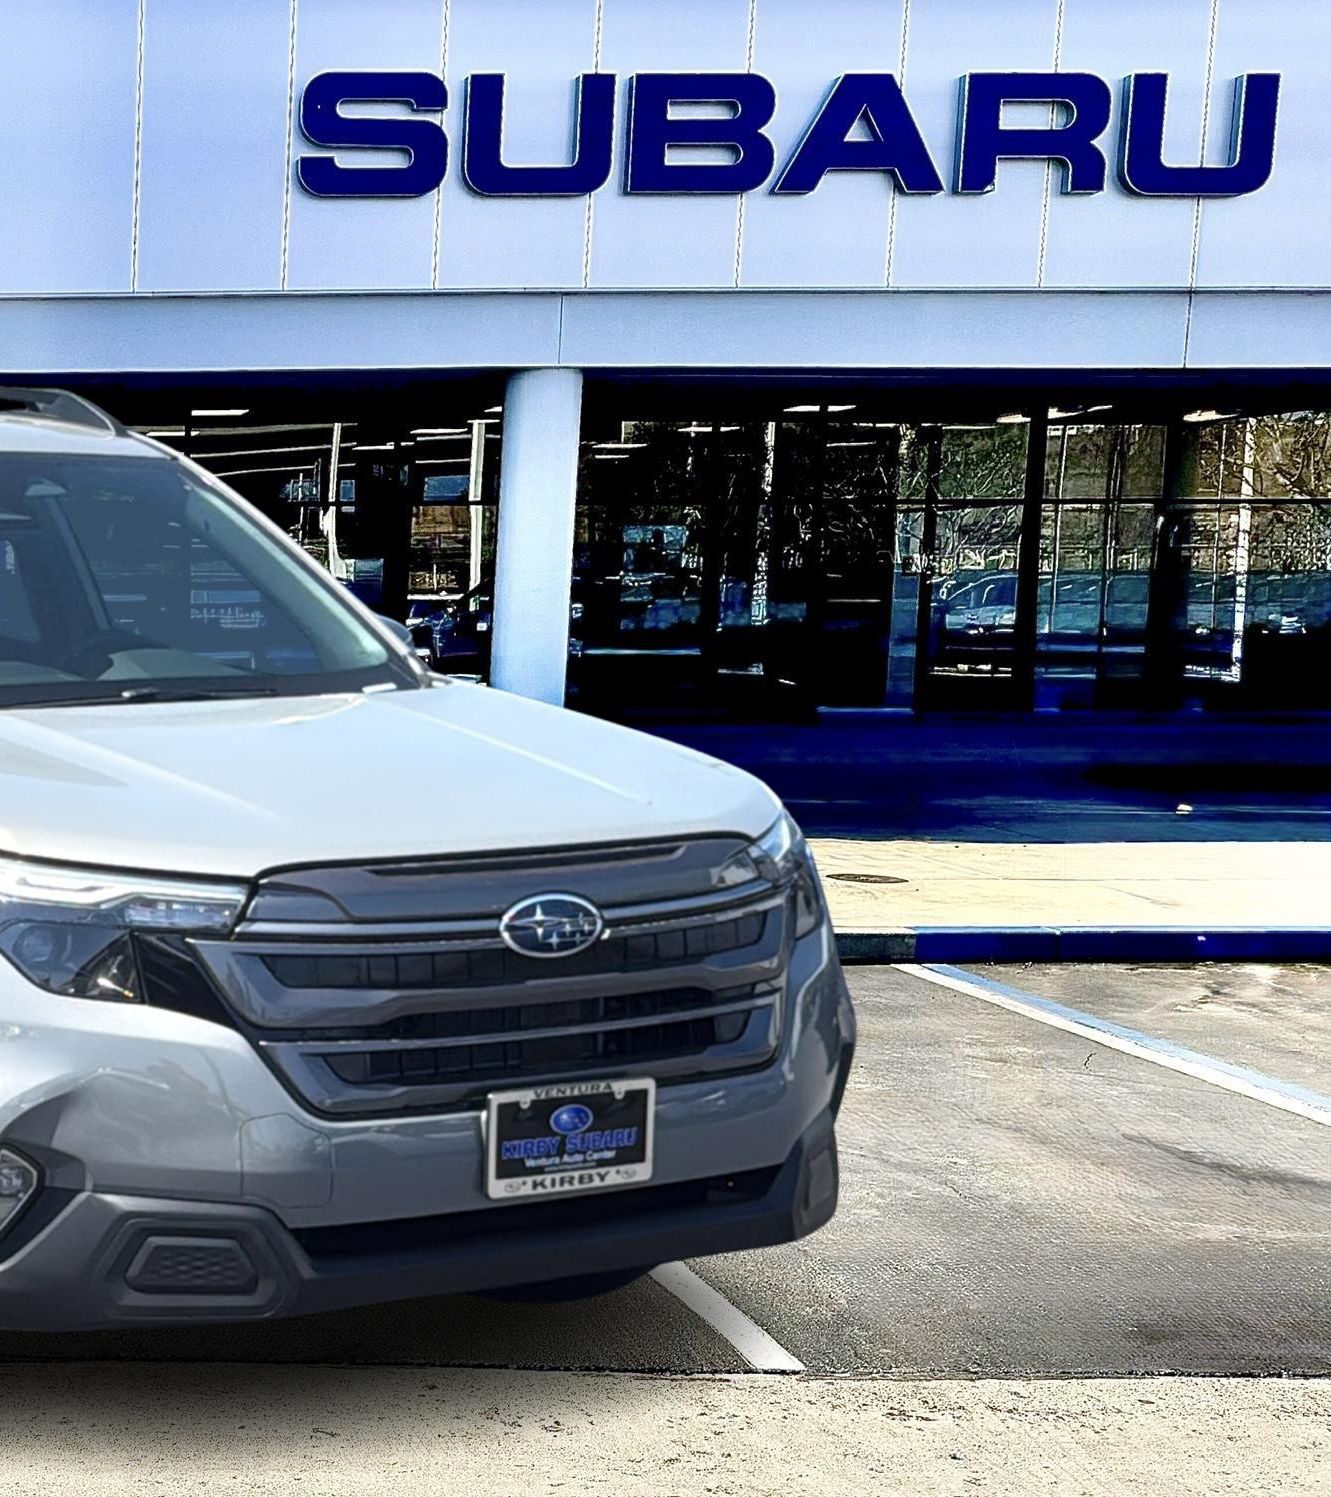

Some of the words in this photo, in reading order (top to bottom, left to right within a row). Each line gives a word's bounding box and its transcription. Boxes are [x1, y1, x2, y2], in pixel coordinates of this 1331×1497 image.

[297, 72, 1280, 197] SUBARU
[534, 1083, 613, 1098] VENTURA
[502, 1137, 560, 1159] KIRBY
[566, 1128, 638, 1152] SUBARU
[524, 1157, 560, 1168] Ventura
[562, 1153, 584, 1163] Auto
[586, 1150, 616, 1161] Center
[531, 1171, 610, 1191] KIRBY
